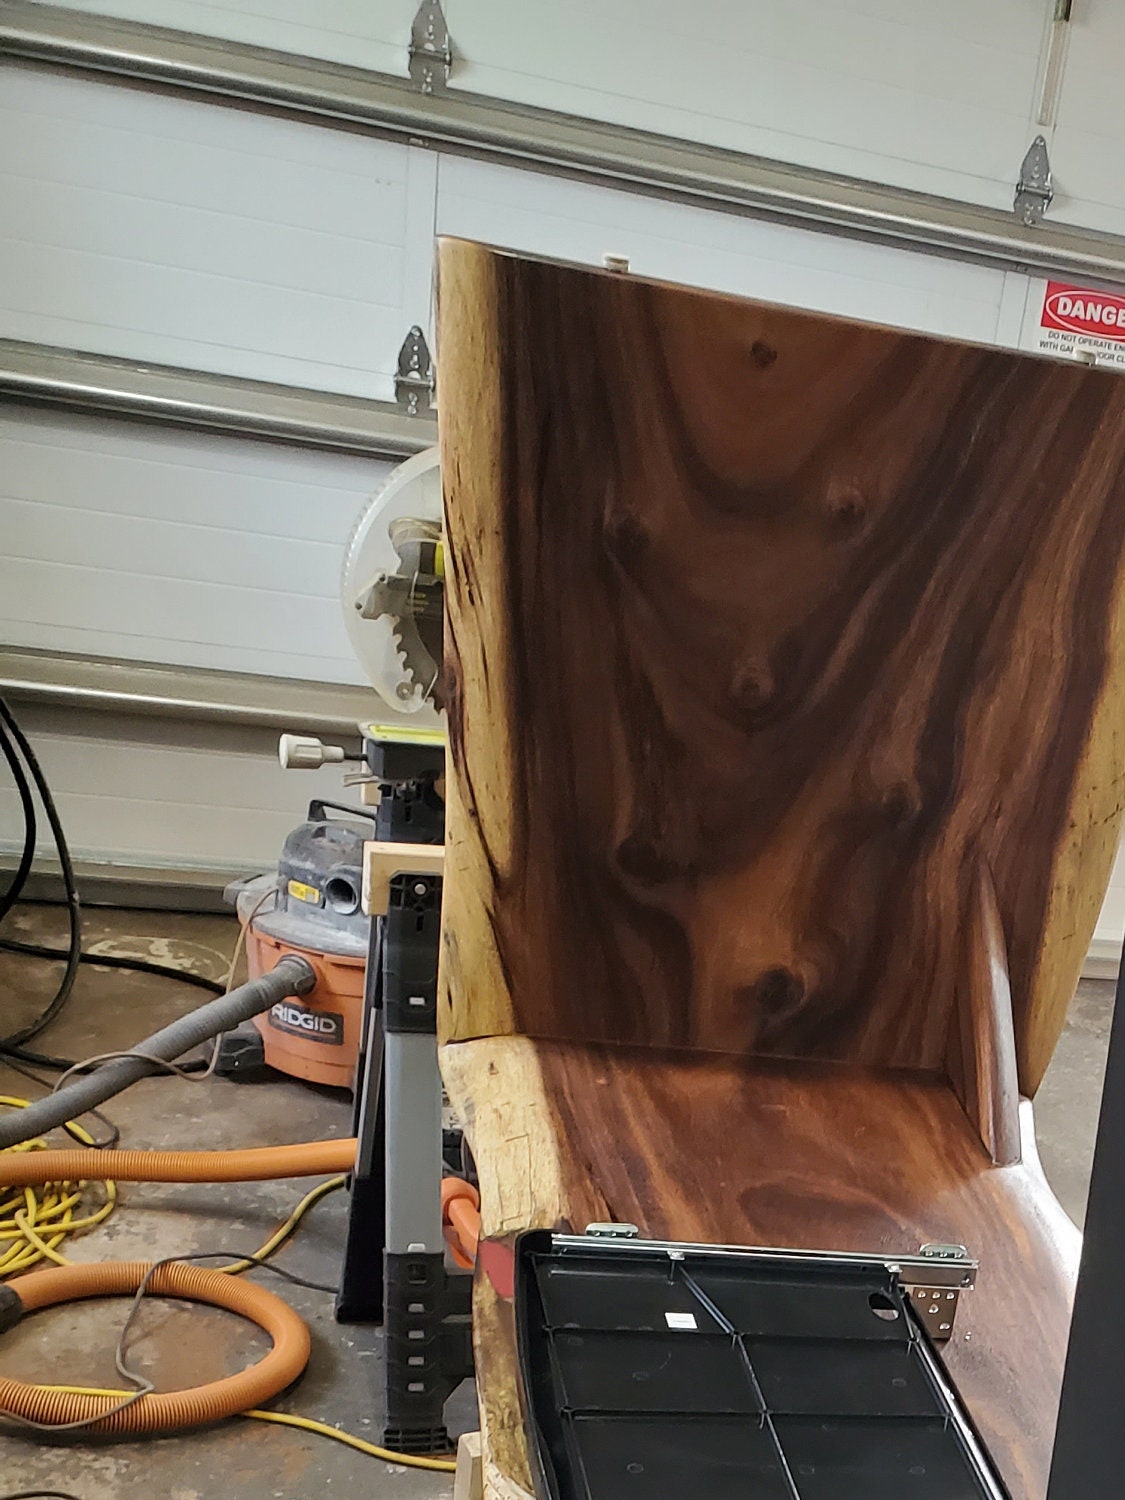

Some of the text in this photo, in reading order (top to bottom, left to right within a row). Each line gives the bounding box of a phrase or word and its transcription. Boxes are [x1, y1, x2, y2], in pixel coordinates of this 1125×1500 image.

[1039, 340, 1059, 350] WITH
[1048, 330, 1060, 340] DO
[1061, 334, 1076, 343] NOT
[1078, 336, 1112, 349] OPERATE
[271, 1003, 336, 1033] RIDGID
